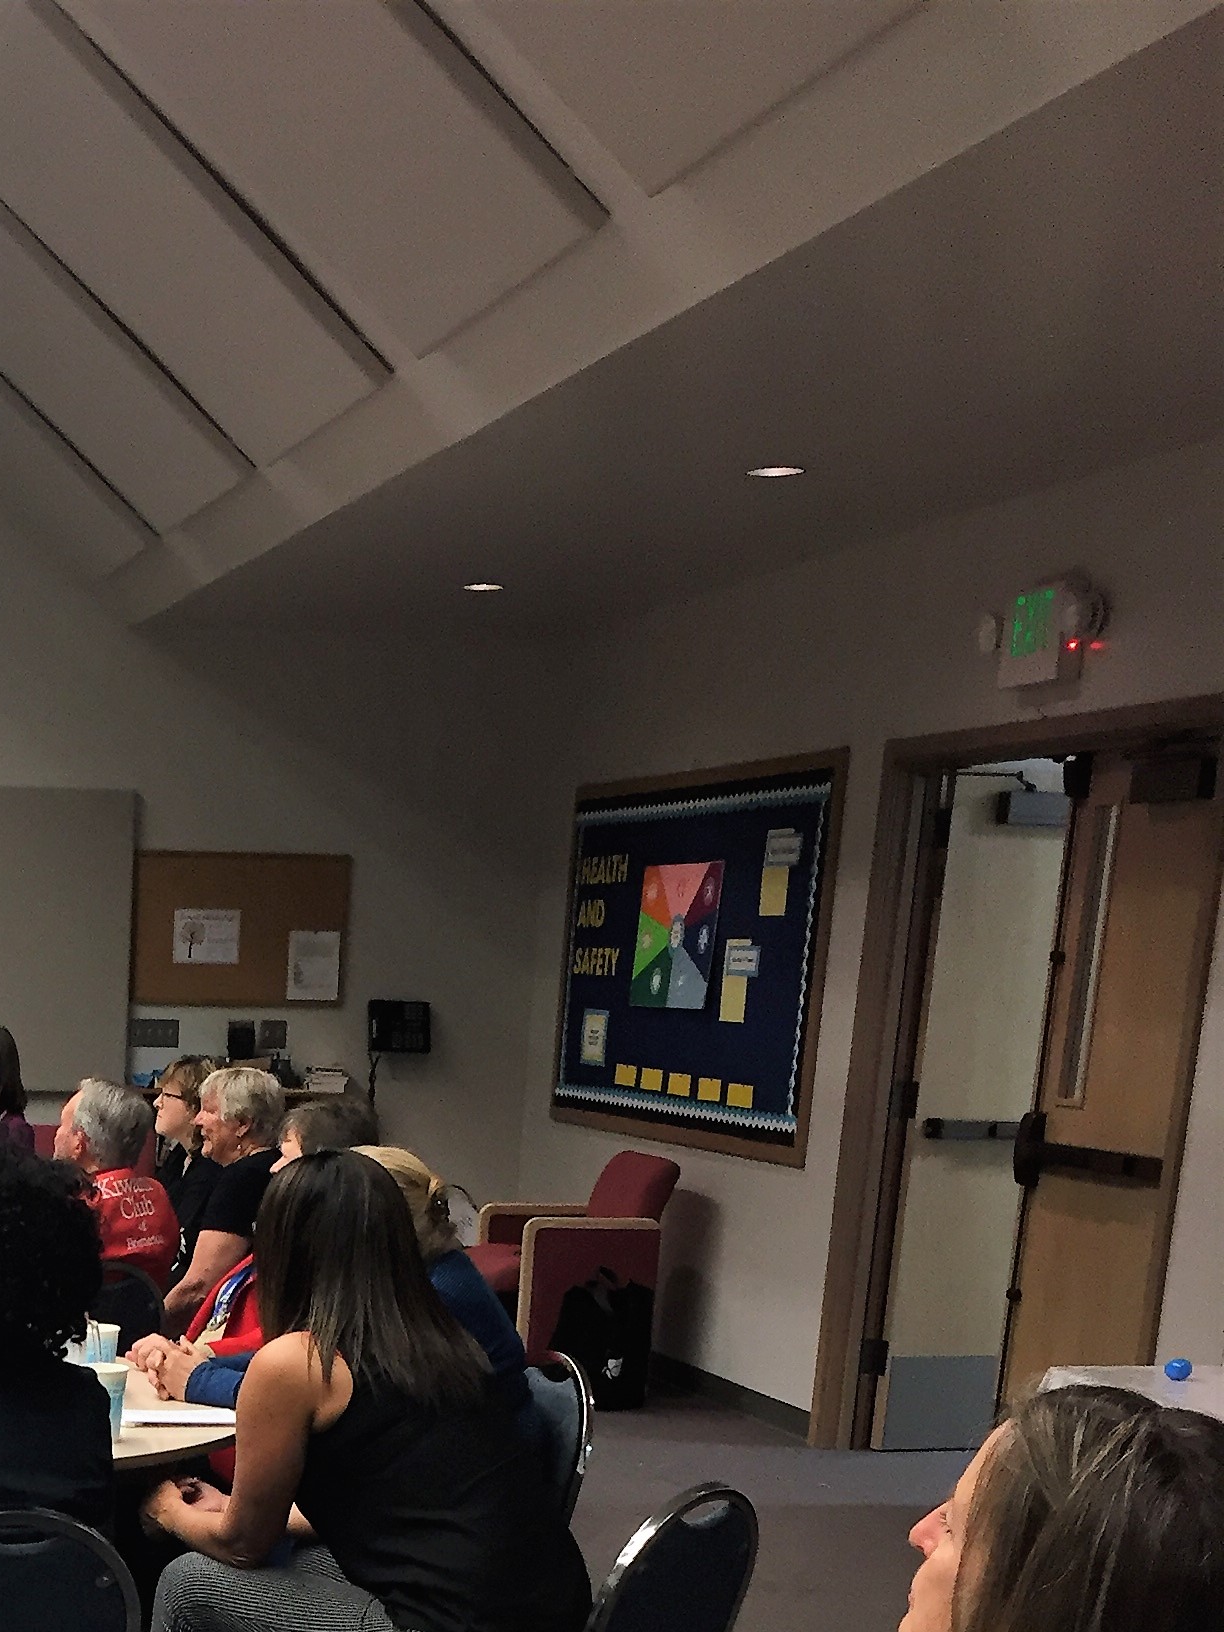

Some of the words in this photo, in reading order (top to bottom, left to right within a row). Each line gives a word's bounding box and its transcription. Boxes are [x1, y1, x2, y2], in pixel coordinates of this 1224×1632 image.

[580, 853, 629, 885] HEALTH
[576, 899, 605, 928] AND
[572, 947, 620, 976] SAFETY
[120, 1194, 155, 1219] Club
